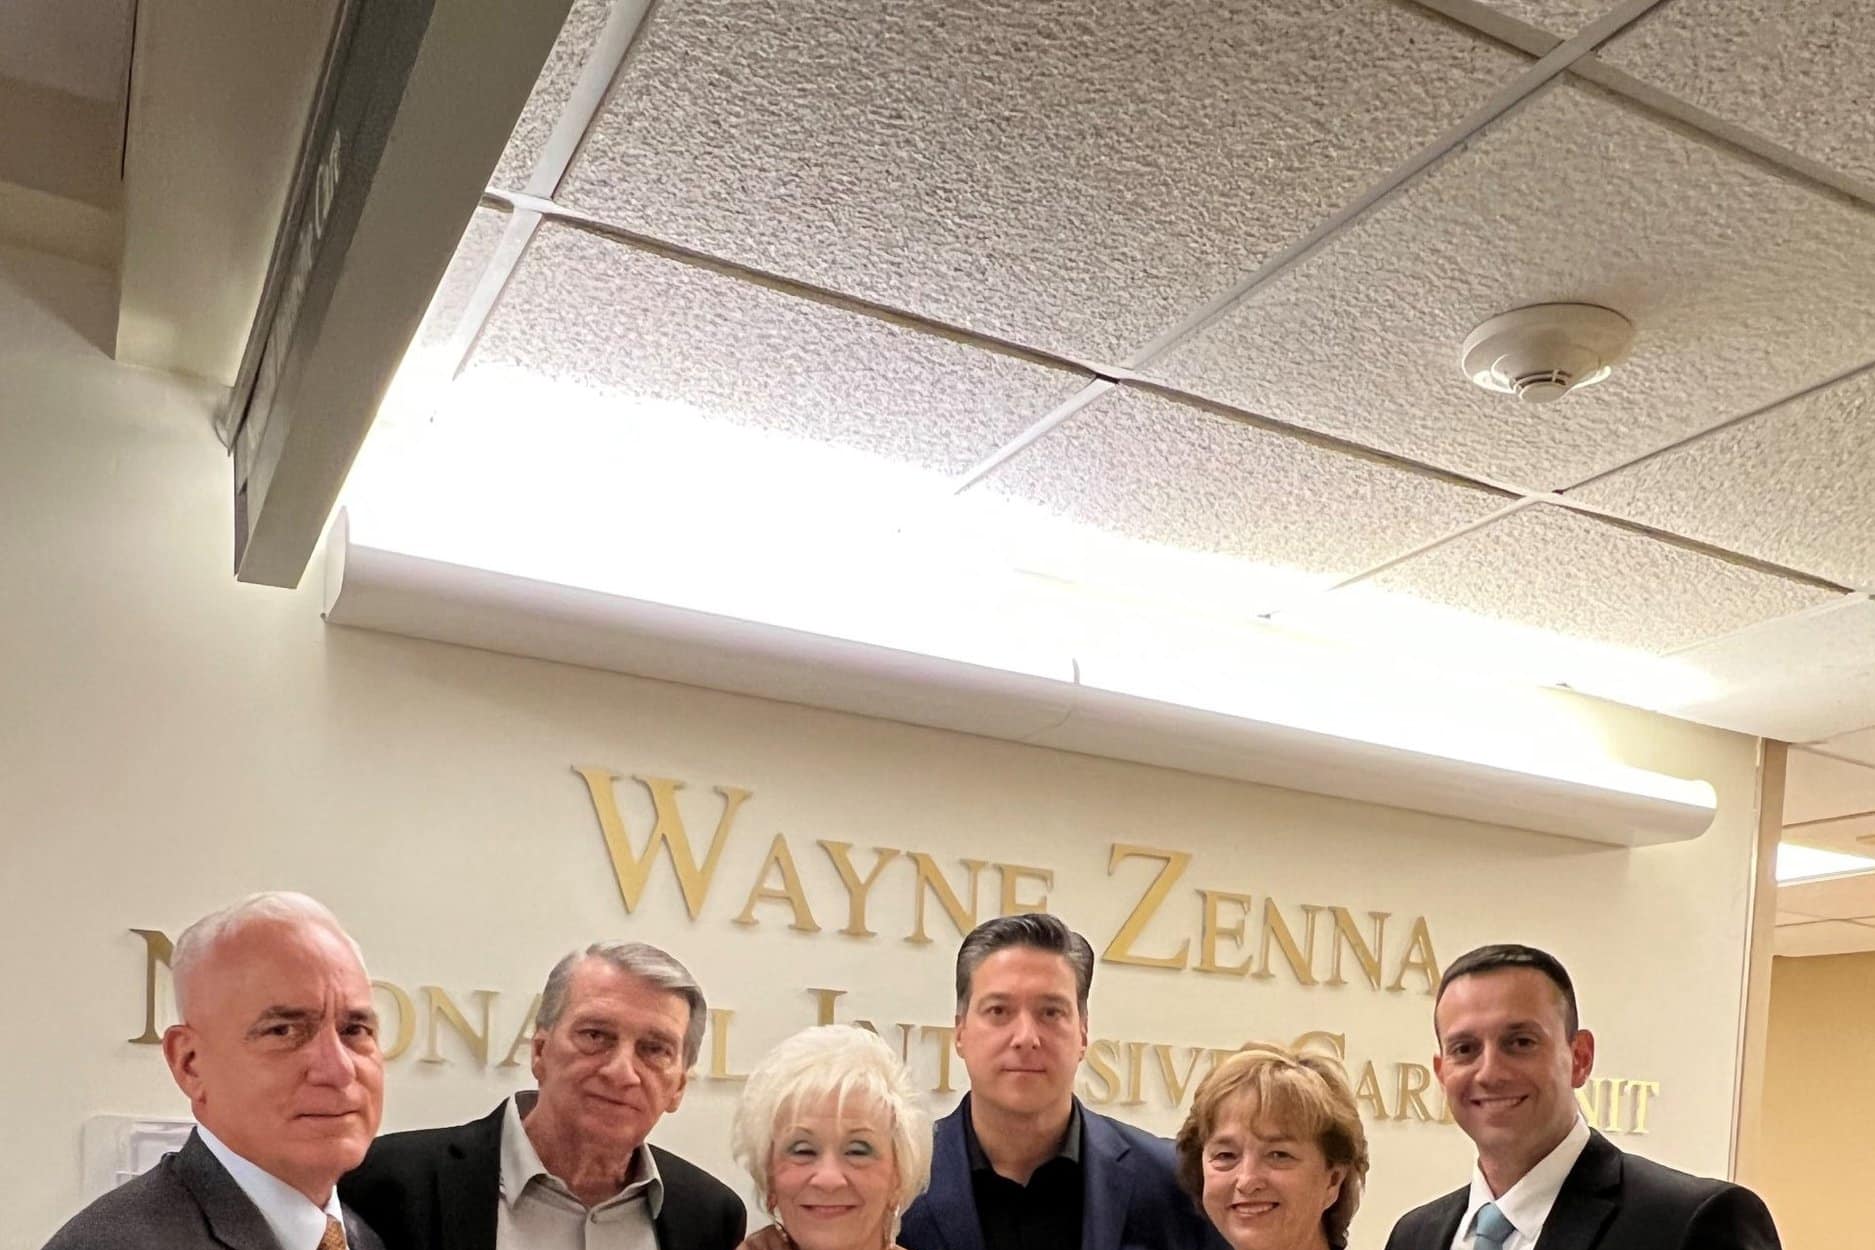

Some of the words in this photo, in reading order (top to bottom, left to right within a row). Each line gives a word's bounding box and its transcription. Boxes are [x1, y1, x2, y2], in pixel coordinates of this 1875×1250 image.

[571, 764, 1055, 944] WAYNE
[1102, 842, 1444, 996] ZENNA
[1289, 1030, 1453, 1122] AR
[1574, 1078, 1660, 1133] NIT
